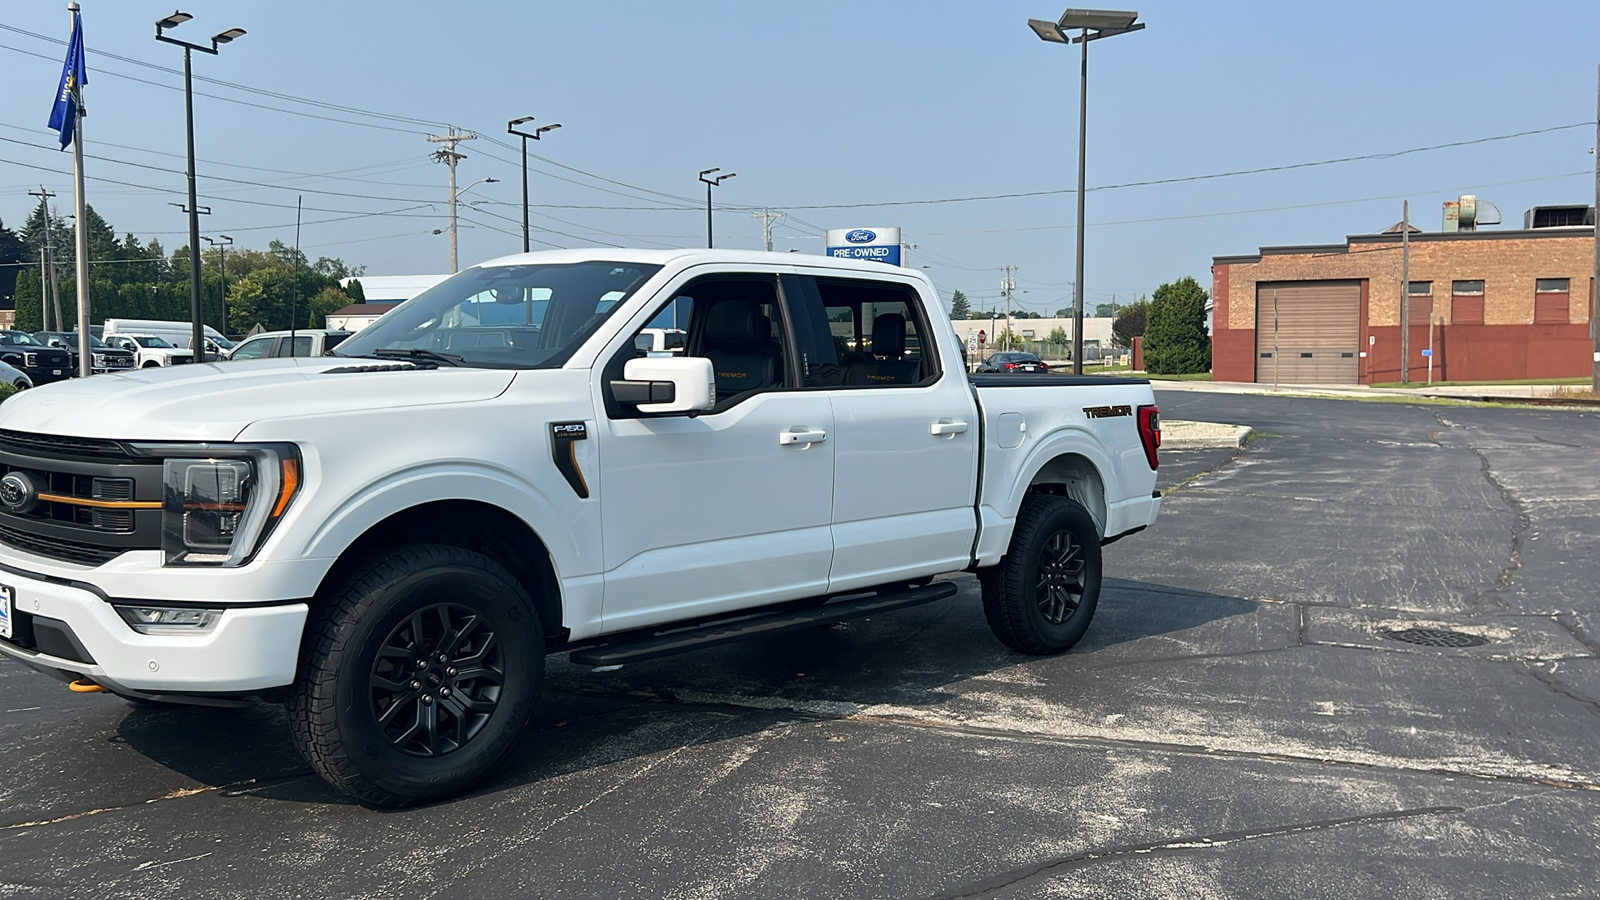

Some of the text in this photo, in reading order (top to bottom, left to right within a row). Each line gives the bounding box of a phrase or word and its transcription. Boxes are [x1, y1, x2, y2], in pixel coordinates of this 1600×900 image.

[850, 232, 869, 241] Ford
[834, 247, 889, 258] PRE-OWNED
[1082, 405, 1132, 418] TREMOR
[554, 424, 585, 433] F-150
